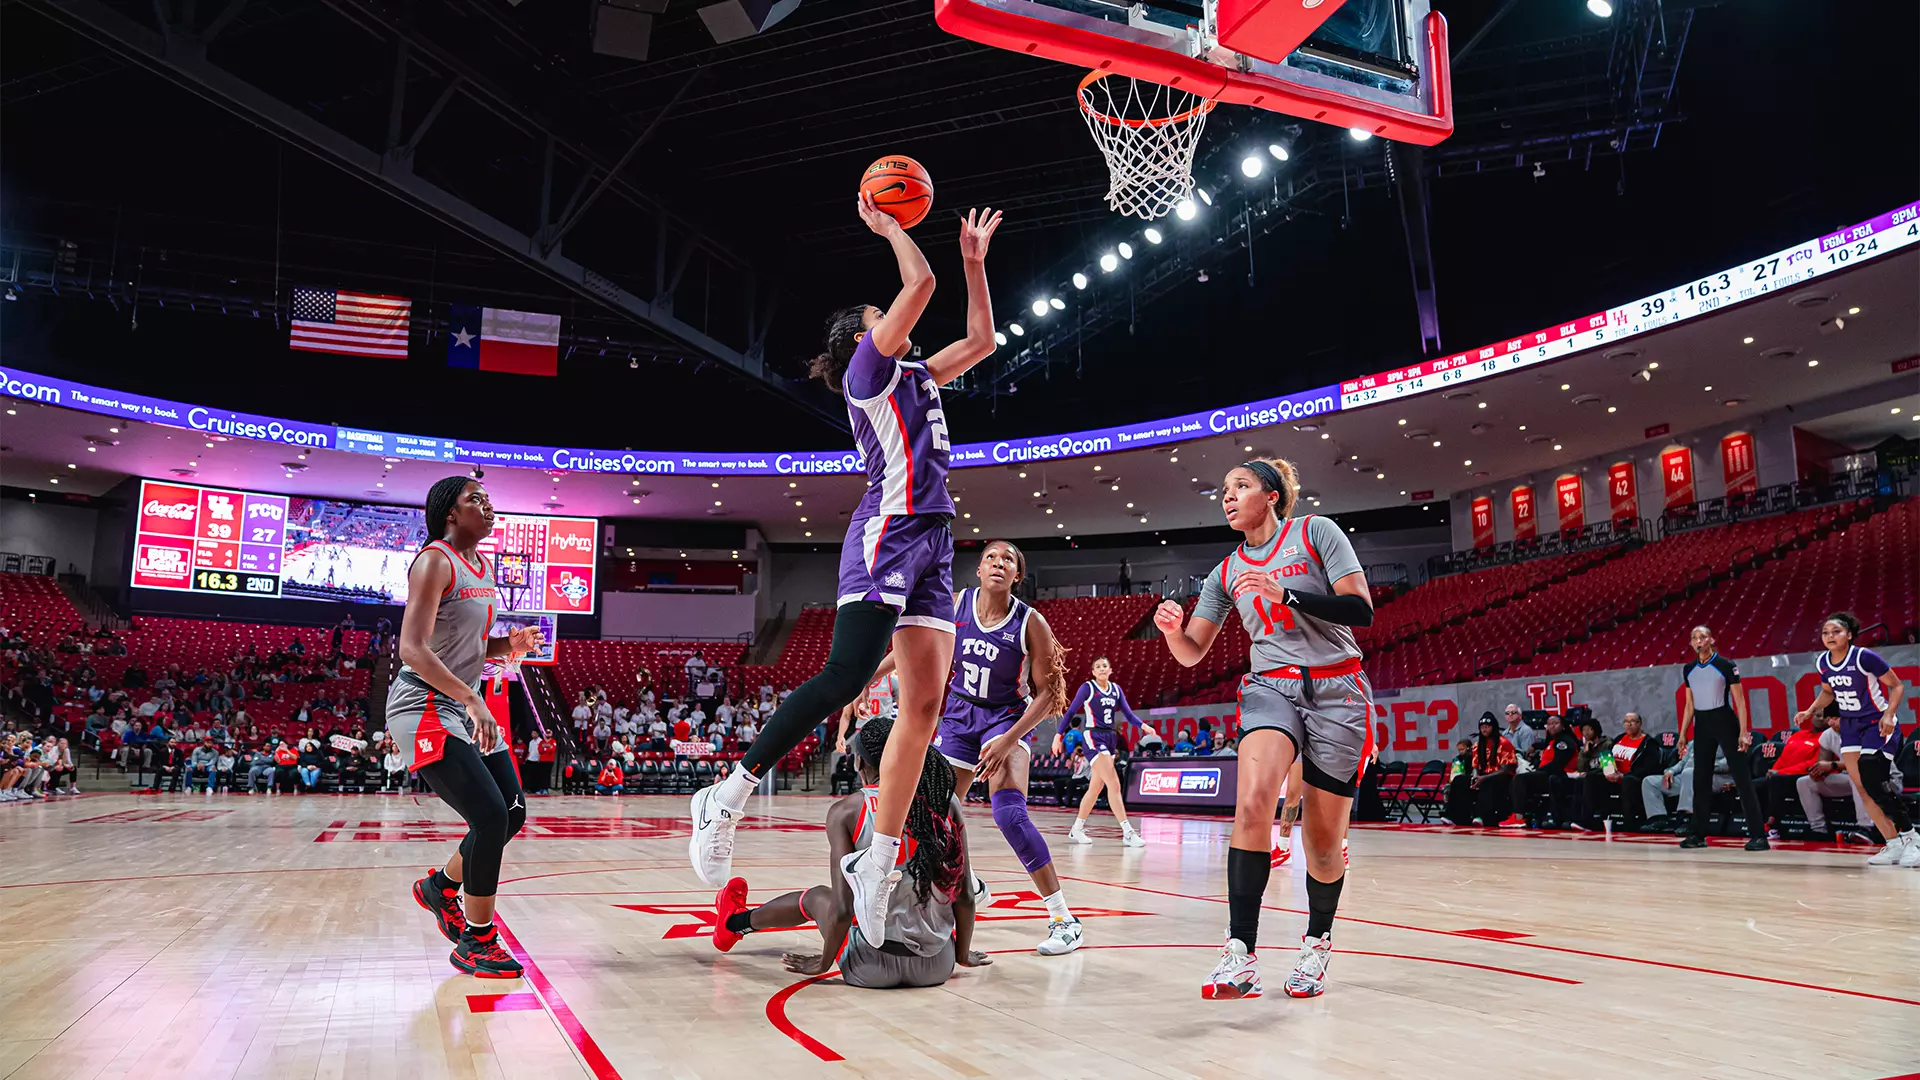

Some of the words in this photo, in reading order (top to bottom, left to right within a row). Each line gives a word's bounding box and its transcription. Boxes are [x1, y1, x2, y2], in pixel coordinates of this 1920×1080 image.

[1823, 233, 1846, 250] FGM
[1853, 223, 1873, 240] FGA
[1786, 249, 1813, 266] TCU
[1828, 238, 1878, 265] 10-24
[1753, 258, 1780, 281] 27
[1685, 274, 1730, 300] 16.3
[1761, 284, 1768, 292] 4
[1774, 273, 1800, 289] FOULS
[1807, 268, 1815, 278] 5
[1641, 298, 1665, 317] 39
[1699, 297, 1720, 312] 2ND
[1644, 316, 1667, 331] FOULS
[1673, 312, 1679, 320] 4
[1595, 329, 1603, 340] 5
[1567, 338, 1573, 348] 1
[1512, 353, 1520, 364] 6
[1539, 346, 1546, 356] 5
[1481, 360, 1496, 371] 18
[71, 390, 88, 402] The
[91, 396, 118, 408] smart
[121, 402, 140, 413] way
[142, 403, 152, 414] to
[154, 406, 178, 419] book.
[346, 431, 383, 443] BASKETBALL
[1118, 433, 1132, 443] The
[1133, 430, 1155, 441] smart
[1156, 427, 1172, 437] way
[1172, 425, 1181, 434] to
[1182, 421, 1202, 432] book.
[396, 447, 435, 456] OKLAHOMA
[455, 447, 469, 456] The
[471, 450, 494, 458] smart
[496, 451, 511, 460] way
[514, 451, 522, 460] to
[524, 452, 544, 462] book.
[966, 449, 986, 459] book.
[682, 458, 696, 467] The
[698, 460, 720, 468] smart
[721, 461, 737, 469] way
[738, 460, 747, 468] to
[748, 459, 768, 468] book.
[1671, 466, 1684, 483] 44
[1616, 479, 1629, 496] 42
[248, 503, 283, 521] TCU
[1518, 503, 1529, 518] 22
[1477, 512, 1487, 527] 10
[207, 523, 232, 538] 39
[252, 528, 276, 542] 27
[551, 533, 592, 550] rhythm
[148, 549, 181, 561] BUD
[225, 549, 232, 558] 4
[140, 558, 187, 573] LIGHT
[224, 559, 232, 567] 4
[267, 562, 275, 571] 4
[197, 571, 238, 590] 16.3
[246, 577, 274, 592] 2ND
[459, 587, 496, 600] HOUST
[1252, 594, 1296, 636] 14
[962, 638, 1000, 662] TCU
[962, 660, 991, 699] 21
[1828, 675, 1852, 688] TCU
[1100, 697, 1116, 707] TCU
[1834, 690, 1861, 711] 55
[1103, 708, 1113, 724] 2
[676, 743, 708, 754] DEFENSE
[1160, 776, 1178, 788] NOW
